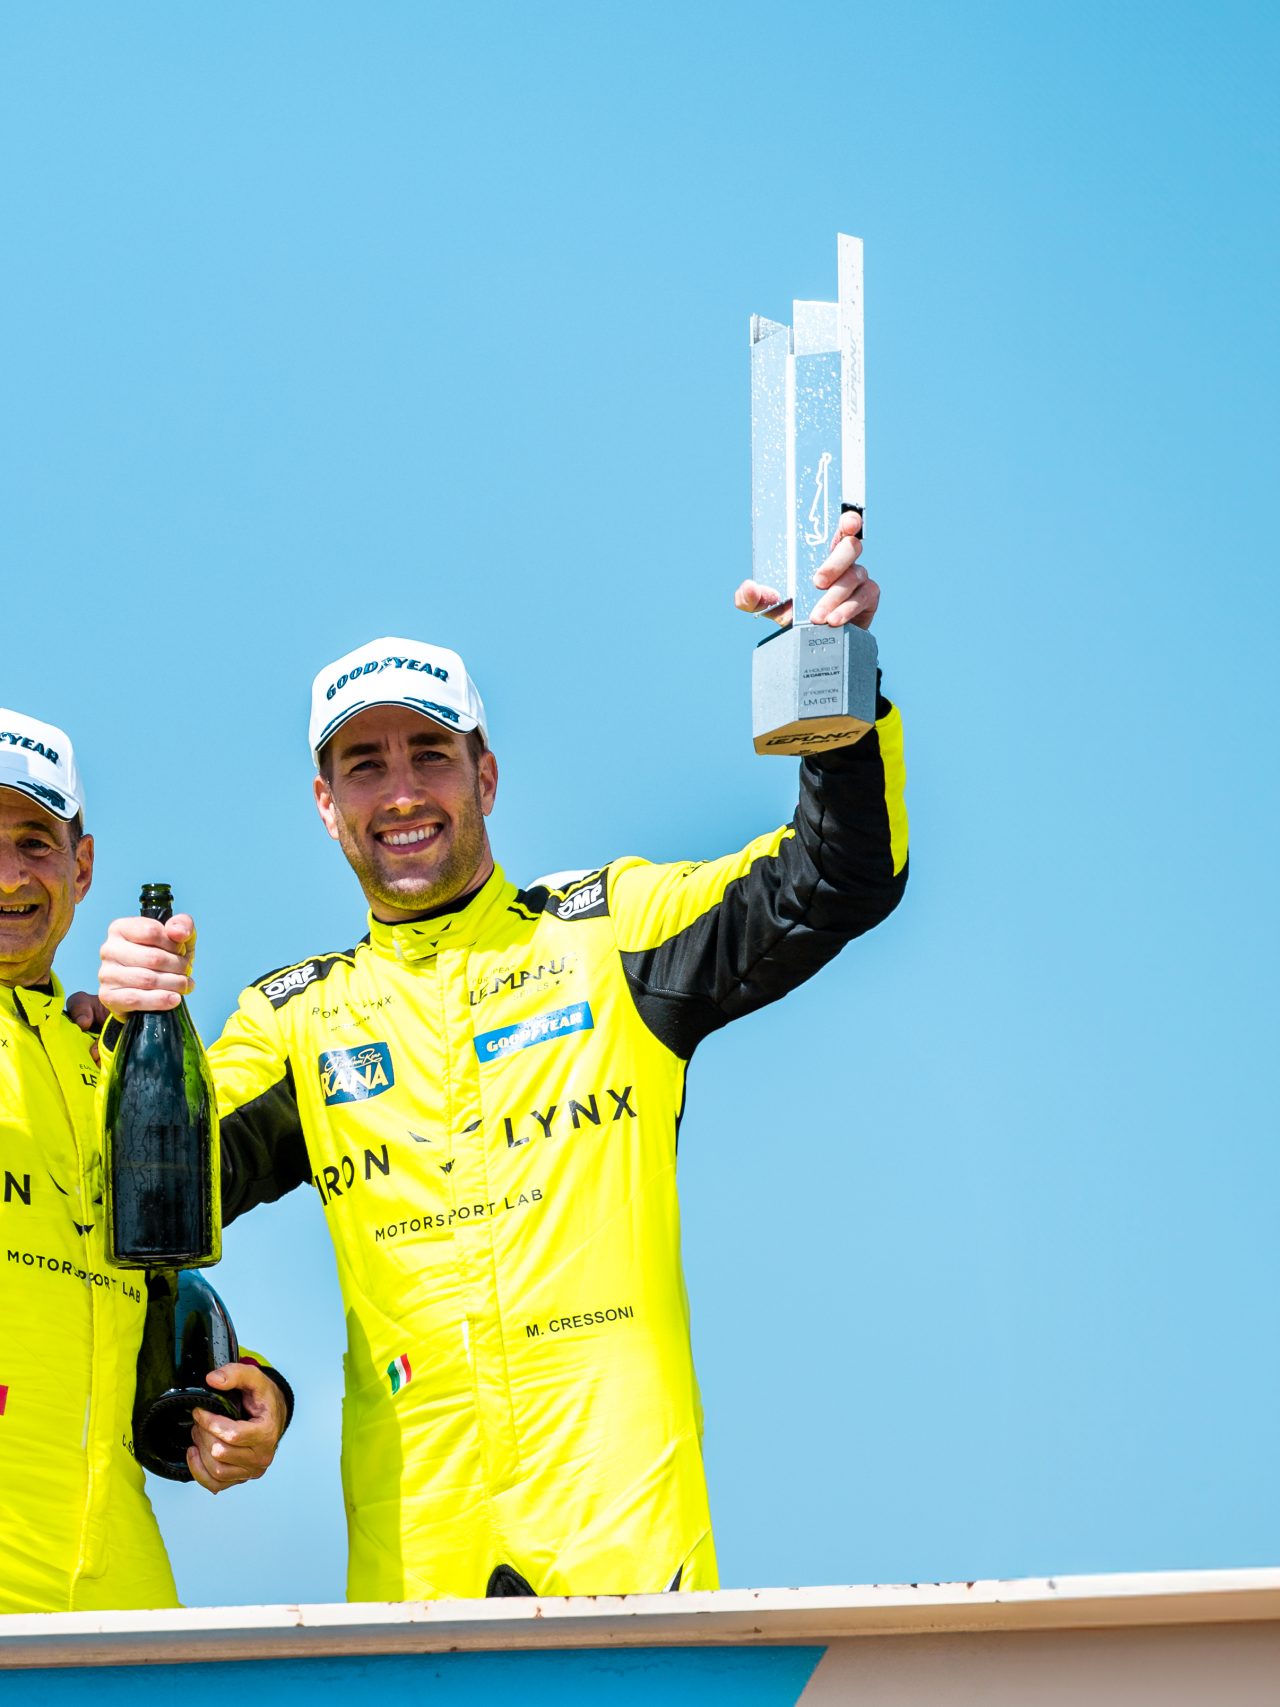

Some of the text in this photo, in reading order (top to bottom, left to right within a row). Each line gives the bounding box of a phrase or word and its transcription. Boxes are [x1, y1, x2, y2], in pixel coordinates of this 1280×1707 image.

[808, 637, 836, 647] 2023
[803, 697, 838, 706] LM GTE
[264, 964, 316, 998] OMP
[312, 1006, 339, 1018] RON
[320, 1062, 389, 1097] RANA
[314, 1085, 637, 1207] IRON LYNX
[375, 1188, 543, 1242] MOTORSPORT LAB
[122, 1281, 141, 1304] LAB
[525, 1305, 634, 1338] M. CRESSONI
